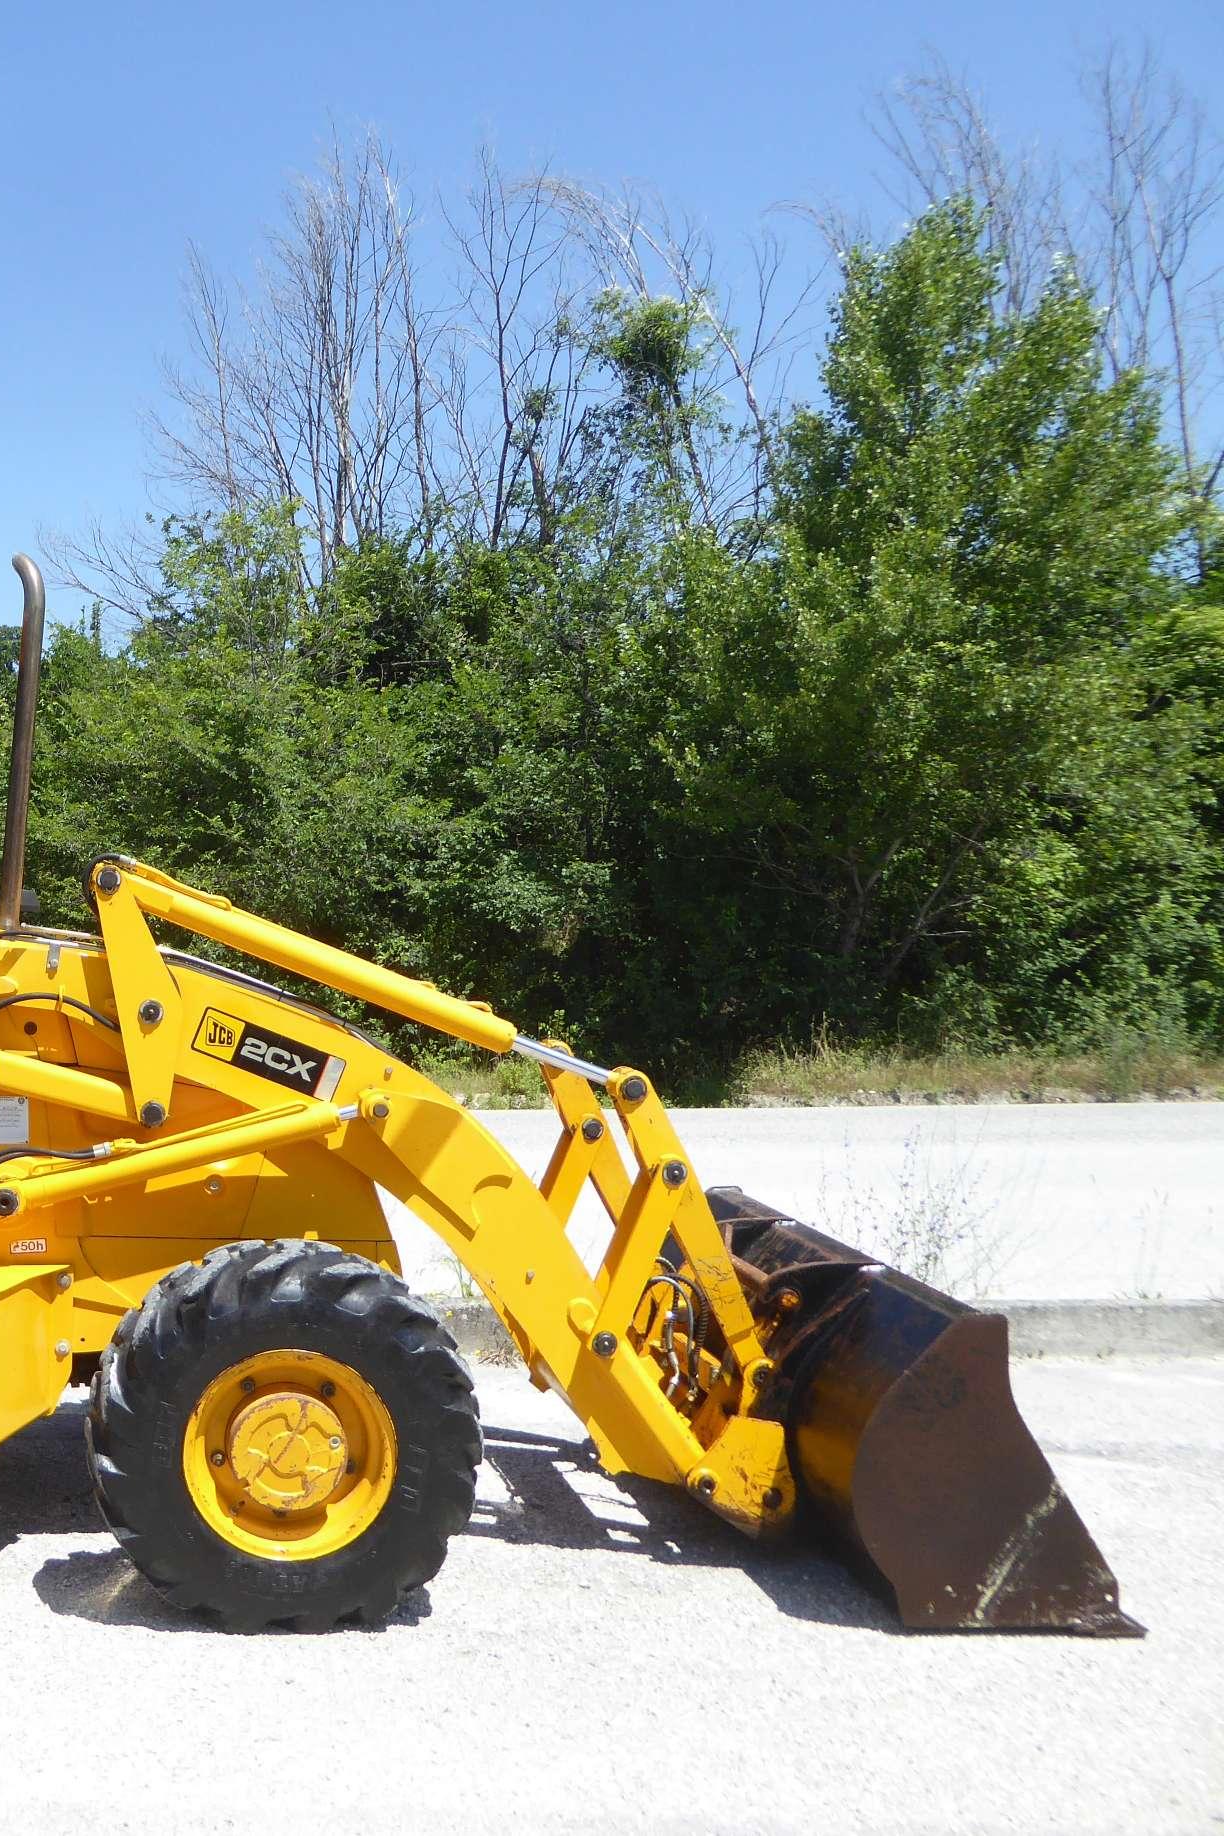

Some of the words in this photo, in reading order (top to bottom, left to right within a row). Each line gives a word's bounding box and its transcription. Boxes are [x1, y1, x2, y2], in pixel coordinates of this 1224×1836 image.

[208, 1021, 233, 1046] JCB
[240, 1037, 317, 1082] 2CX
[20, 1240, 44, 1251] 50h
